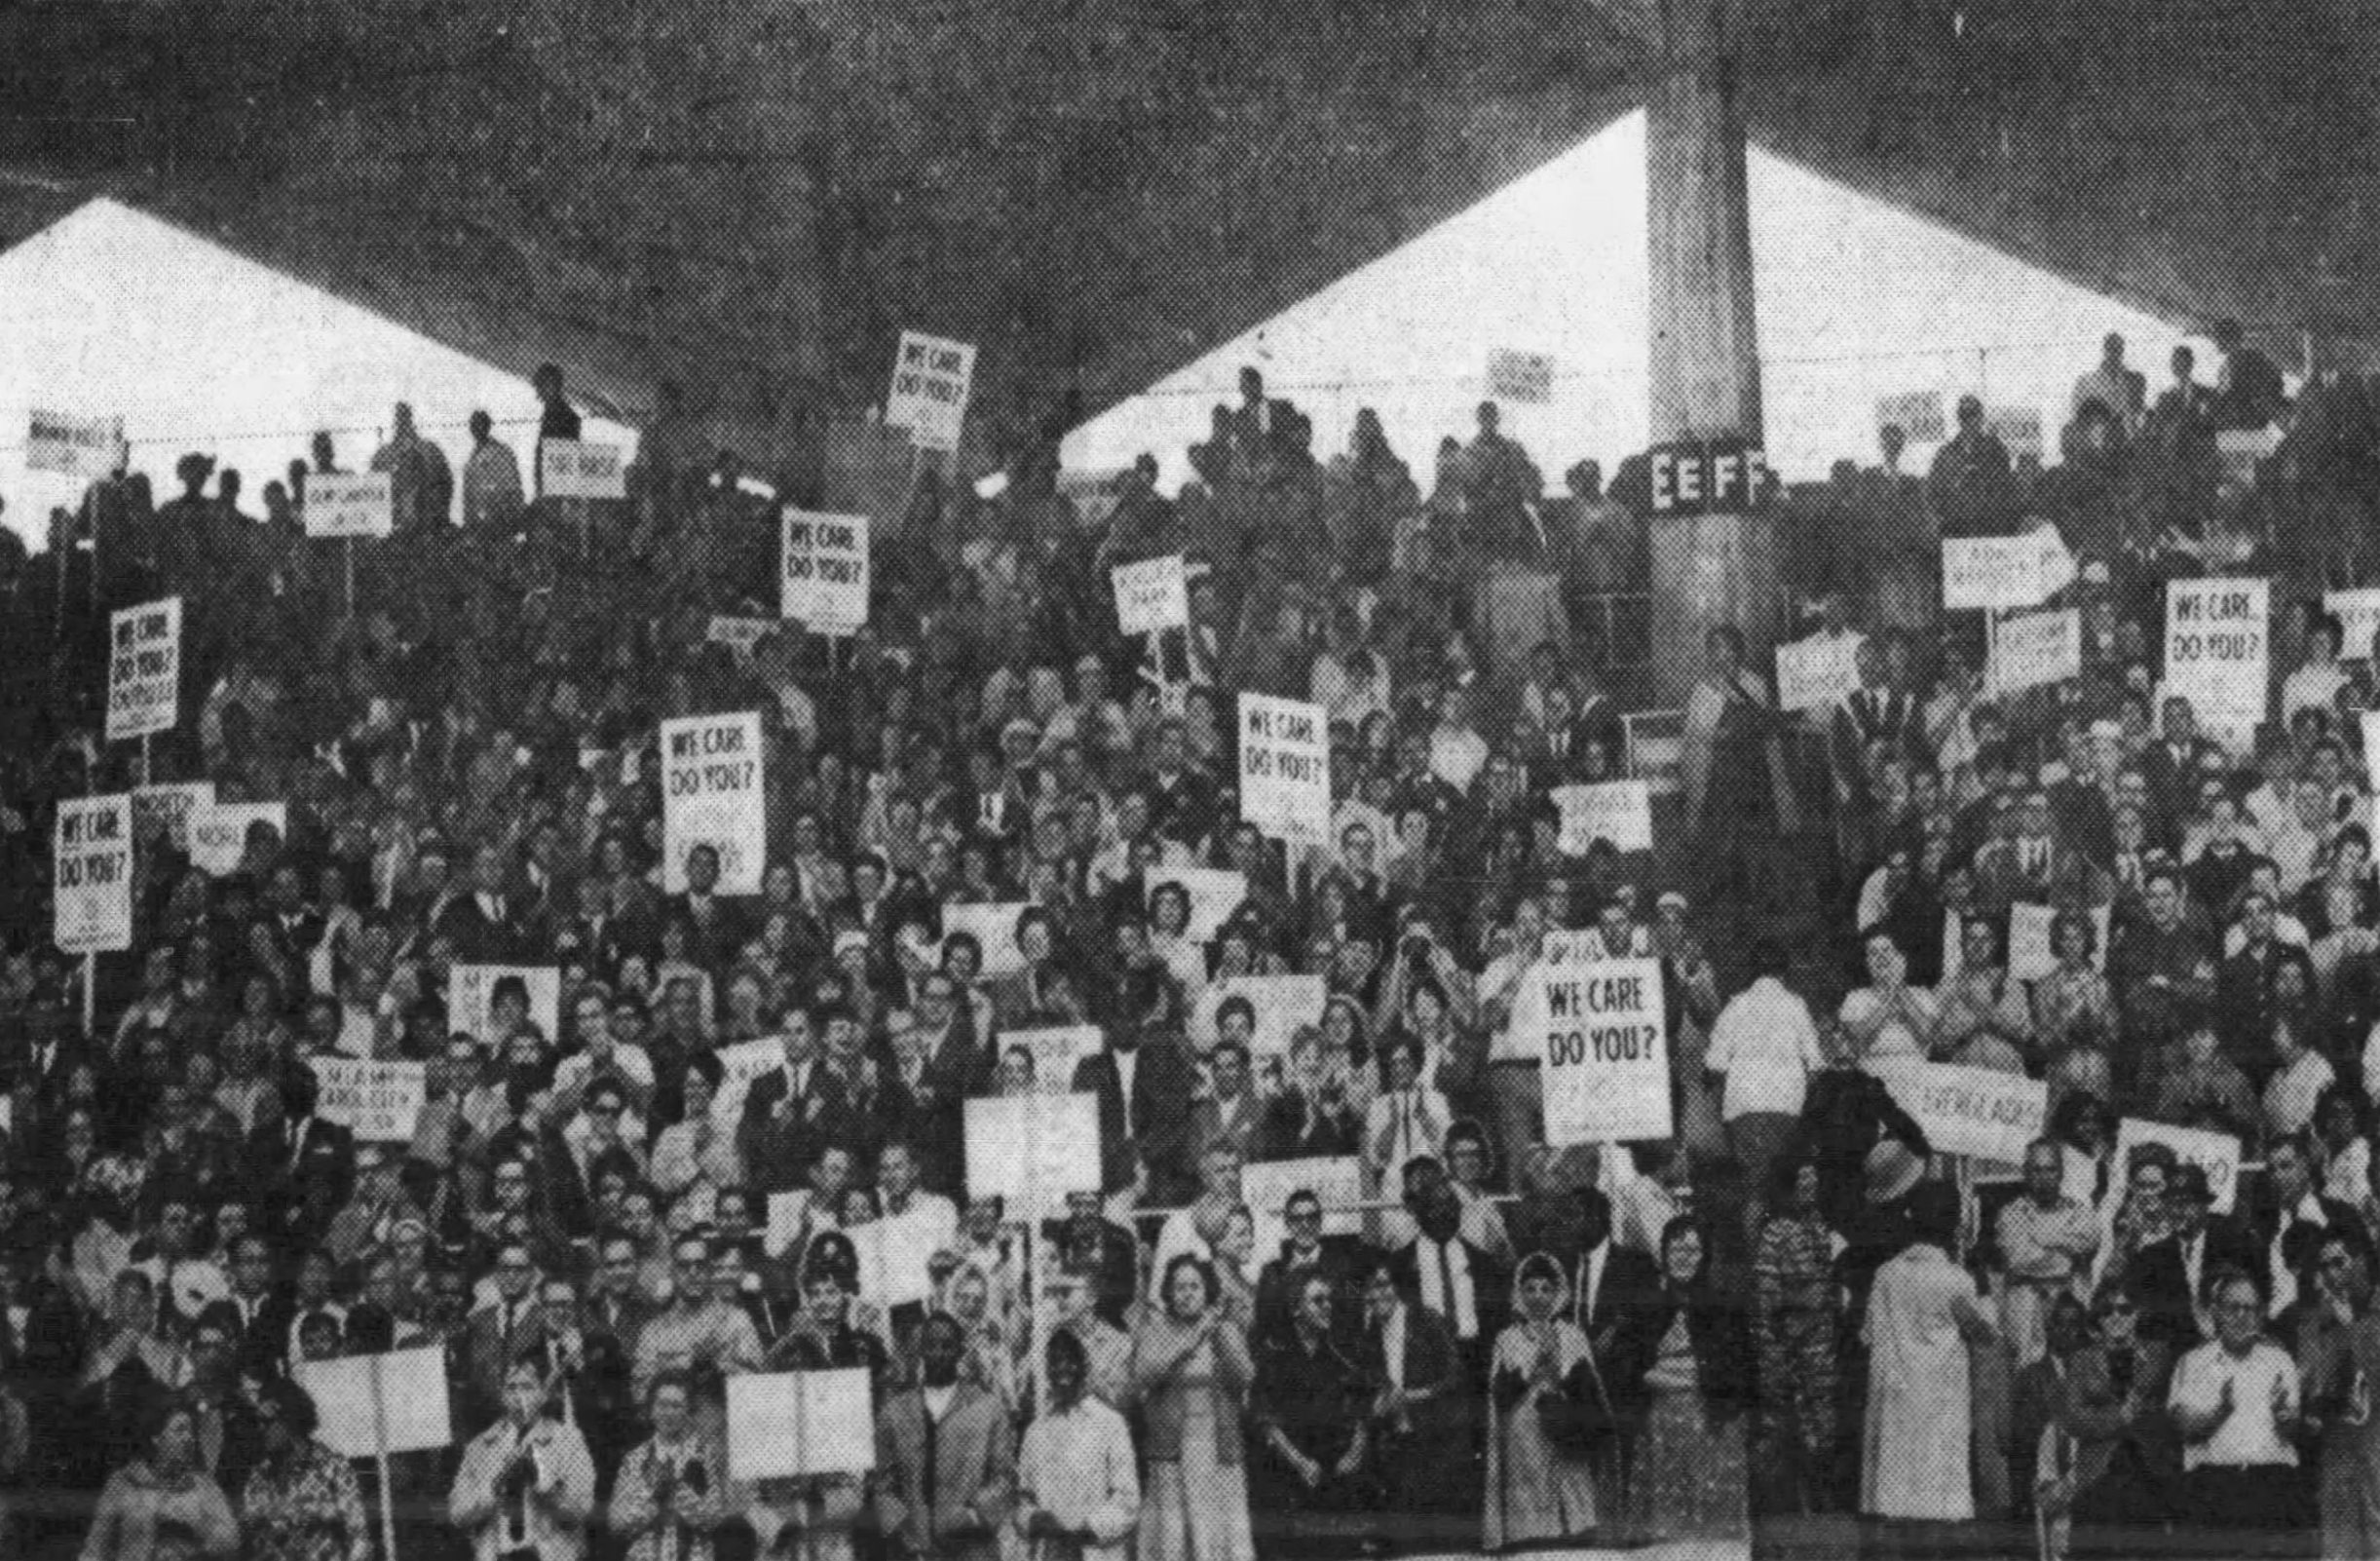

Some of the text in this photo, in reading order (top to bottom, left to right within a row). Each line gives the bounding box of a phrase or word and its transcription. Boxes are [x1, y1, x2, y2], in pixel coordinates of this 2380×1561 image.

[790, 522, 855, 552] WE CARE
[788, 555, 862, 586] DO YOU?
[2174, 593, 2252, 622] WE CARE
[2172, 631, 2260, 661] DO YOU?
[1248, 707, 1314, 743] WE CARE
[670, 725, 746, 760] WE CARE
[670, 762, 754, 795] DO YOU?
[1247, 745, 1323, 786] DO YOU?
[1546, 975, 1643, 1018] WE CARE
[1548, 1023, 1657, 1068] DO YOU?
